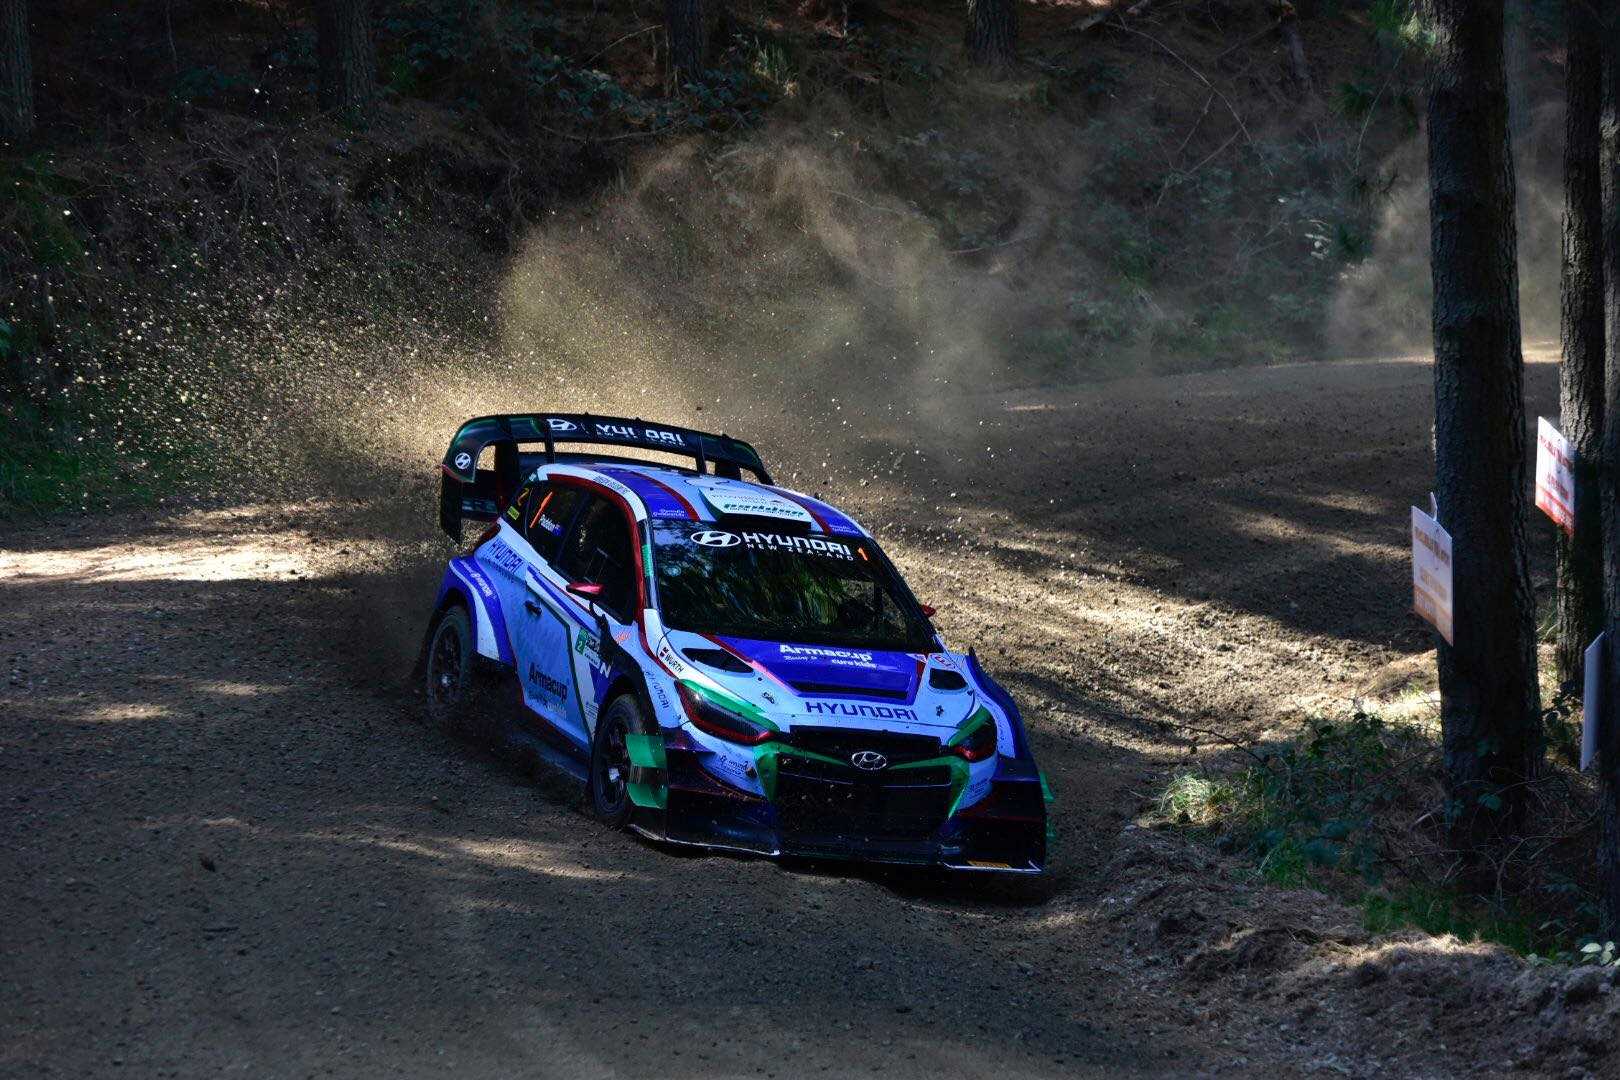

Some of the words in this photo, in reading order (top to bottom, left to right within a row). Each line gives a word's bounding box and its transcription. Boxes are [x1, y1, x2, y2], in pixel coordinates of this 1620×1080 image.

[742, 532, 851, 556] HYUNDAI
[747, 543, 777, 551] NEW
[788, 546, 854, 561] ZEALAND
[487, 541, 524, 573] HYUNDAI
[780, 644, 872, 664] Armacup
[805, 701, 919, 721] HYUNDAI
